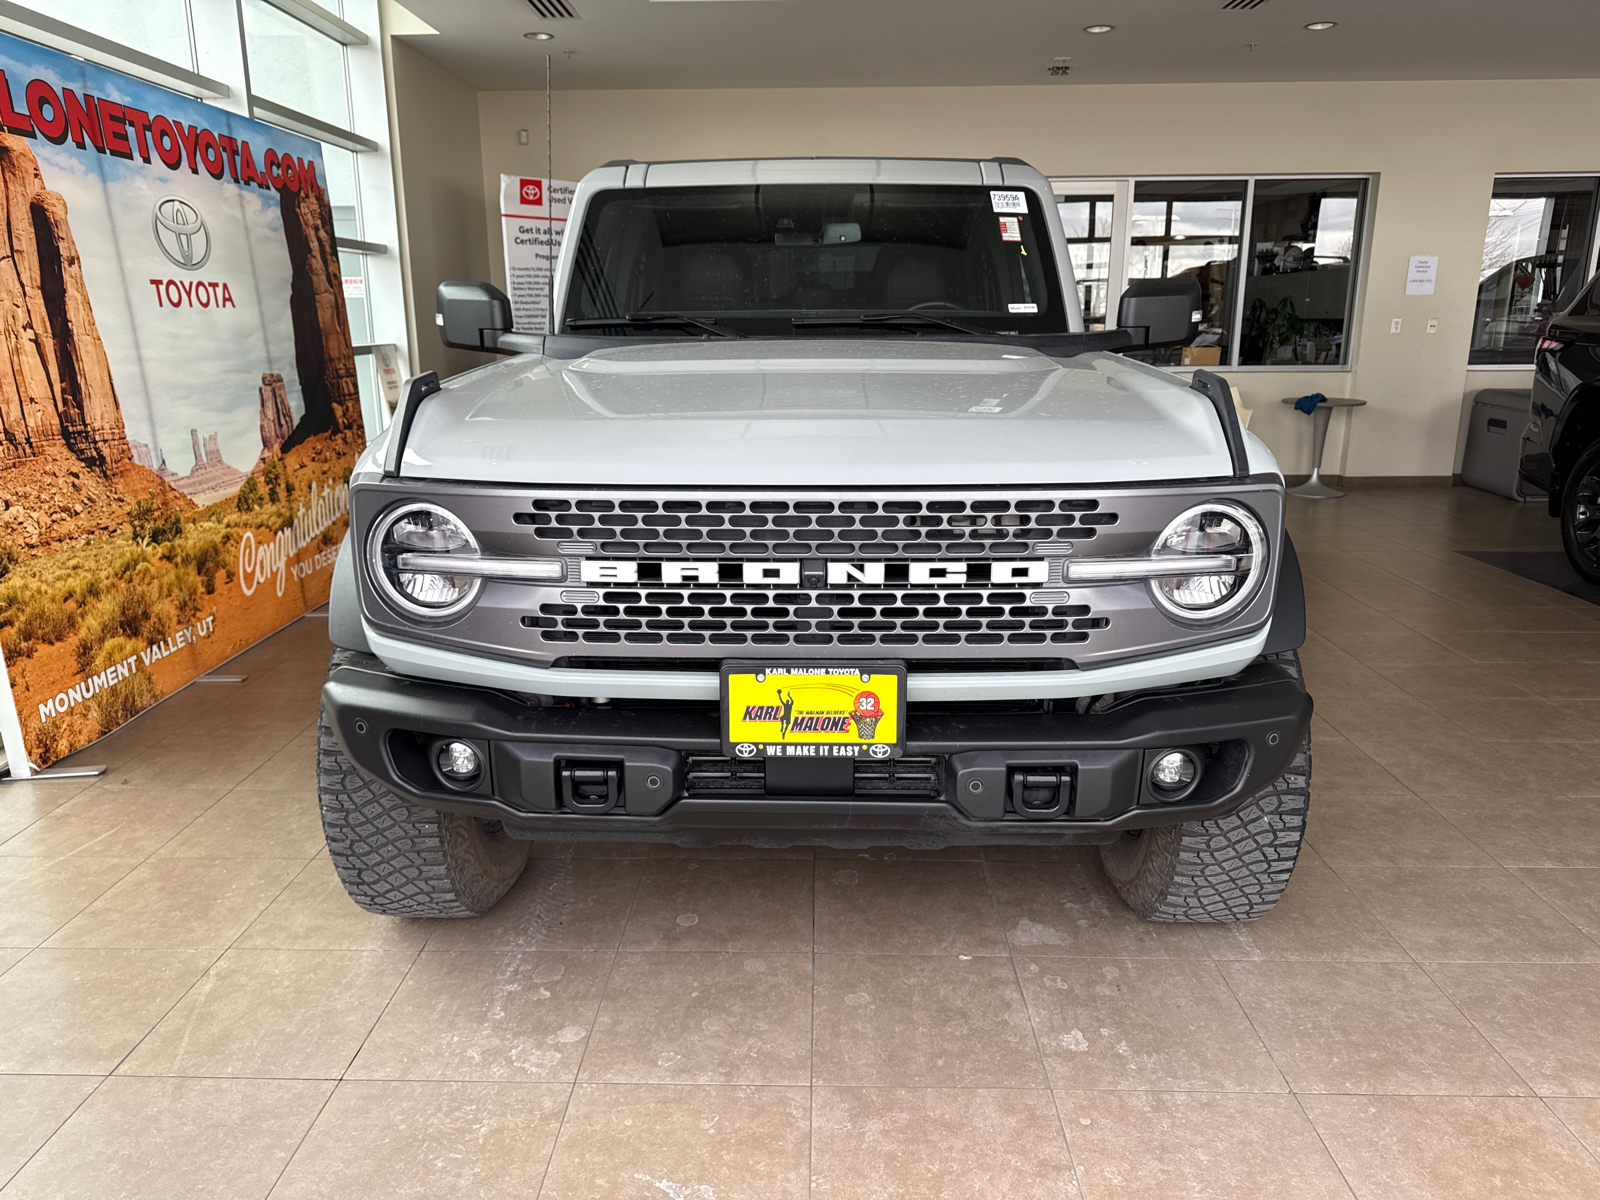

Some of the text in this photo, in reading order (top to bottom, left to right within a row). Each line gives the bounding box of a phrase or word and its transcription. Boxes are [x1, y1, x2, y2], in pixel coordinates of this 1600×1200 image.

[0, 69, 320, 198] LONETOYOTA.COM
[548, 186, 576, 195] Certifie
[518, 226, 534, 234] Get
[535, 226, 541, 234] it
[514, 237, 550, 246] Certified
[149, 278, 236, 309] TOYOTA
[239, 478, 350, 597] Congratulation
[290, 558, 313, 582] YOU
[580, 560, 1049, 584] BRONCO
[38, 615, 214, 723] MONUMENT VALLEY, UT
[765, 668, 861, 676] KARL MALONE TOYOTA
[859, 697, 875, 711] 32
[742, 705, 783, 722] KARL
[790, 715, 850, 733] MALONE
[766, 745, 860, 756] WE MAKE IT EASY
